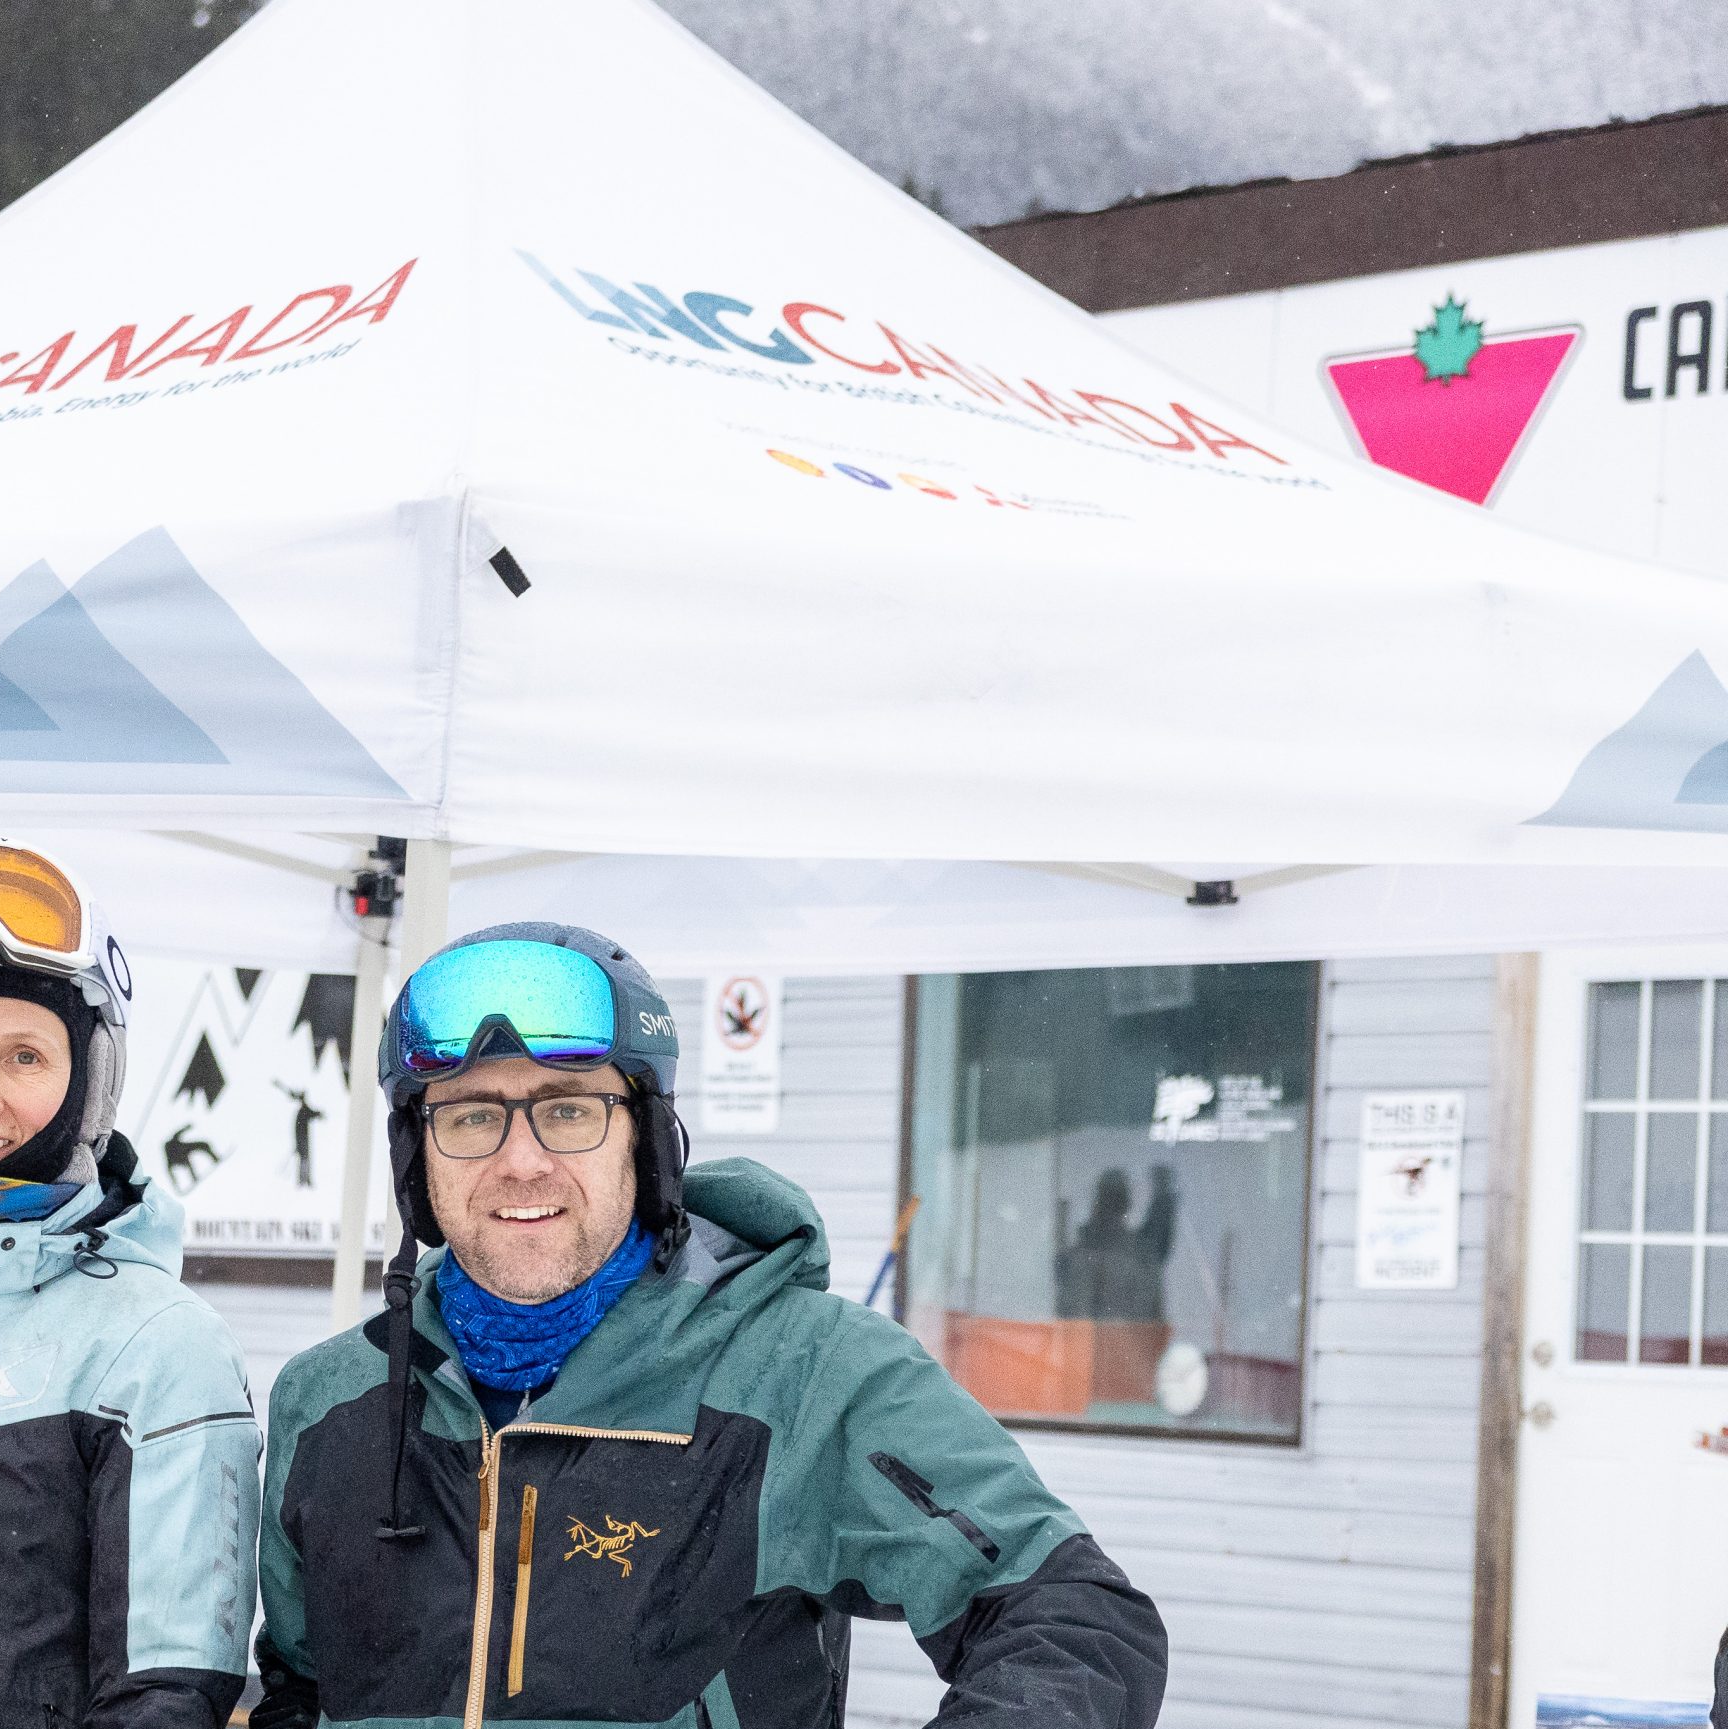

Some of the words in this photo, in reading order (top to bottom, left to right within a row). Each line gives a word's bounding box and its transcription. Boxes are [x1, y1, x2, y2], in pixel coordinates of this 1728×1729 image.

[55, 388, 161, 415] Energy
[162, 379, 211, 398] for
[213, 365, 263, 387] the
[267, 338, 363, 376] world
[1625, 299, 1728, 400] CA
[638, 1011, 676, 1038] SMIT
